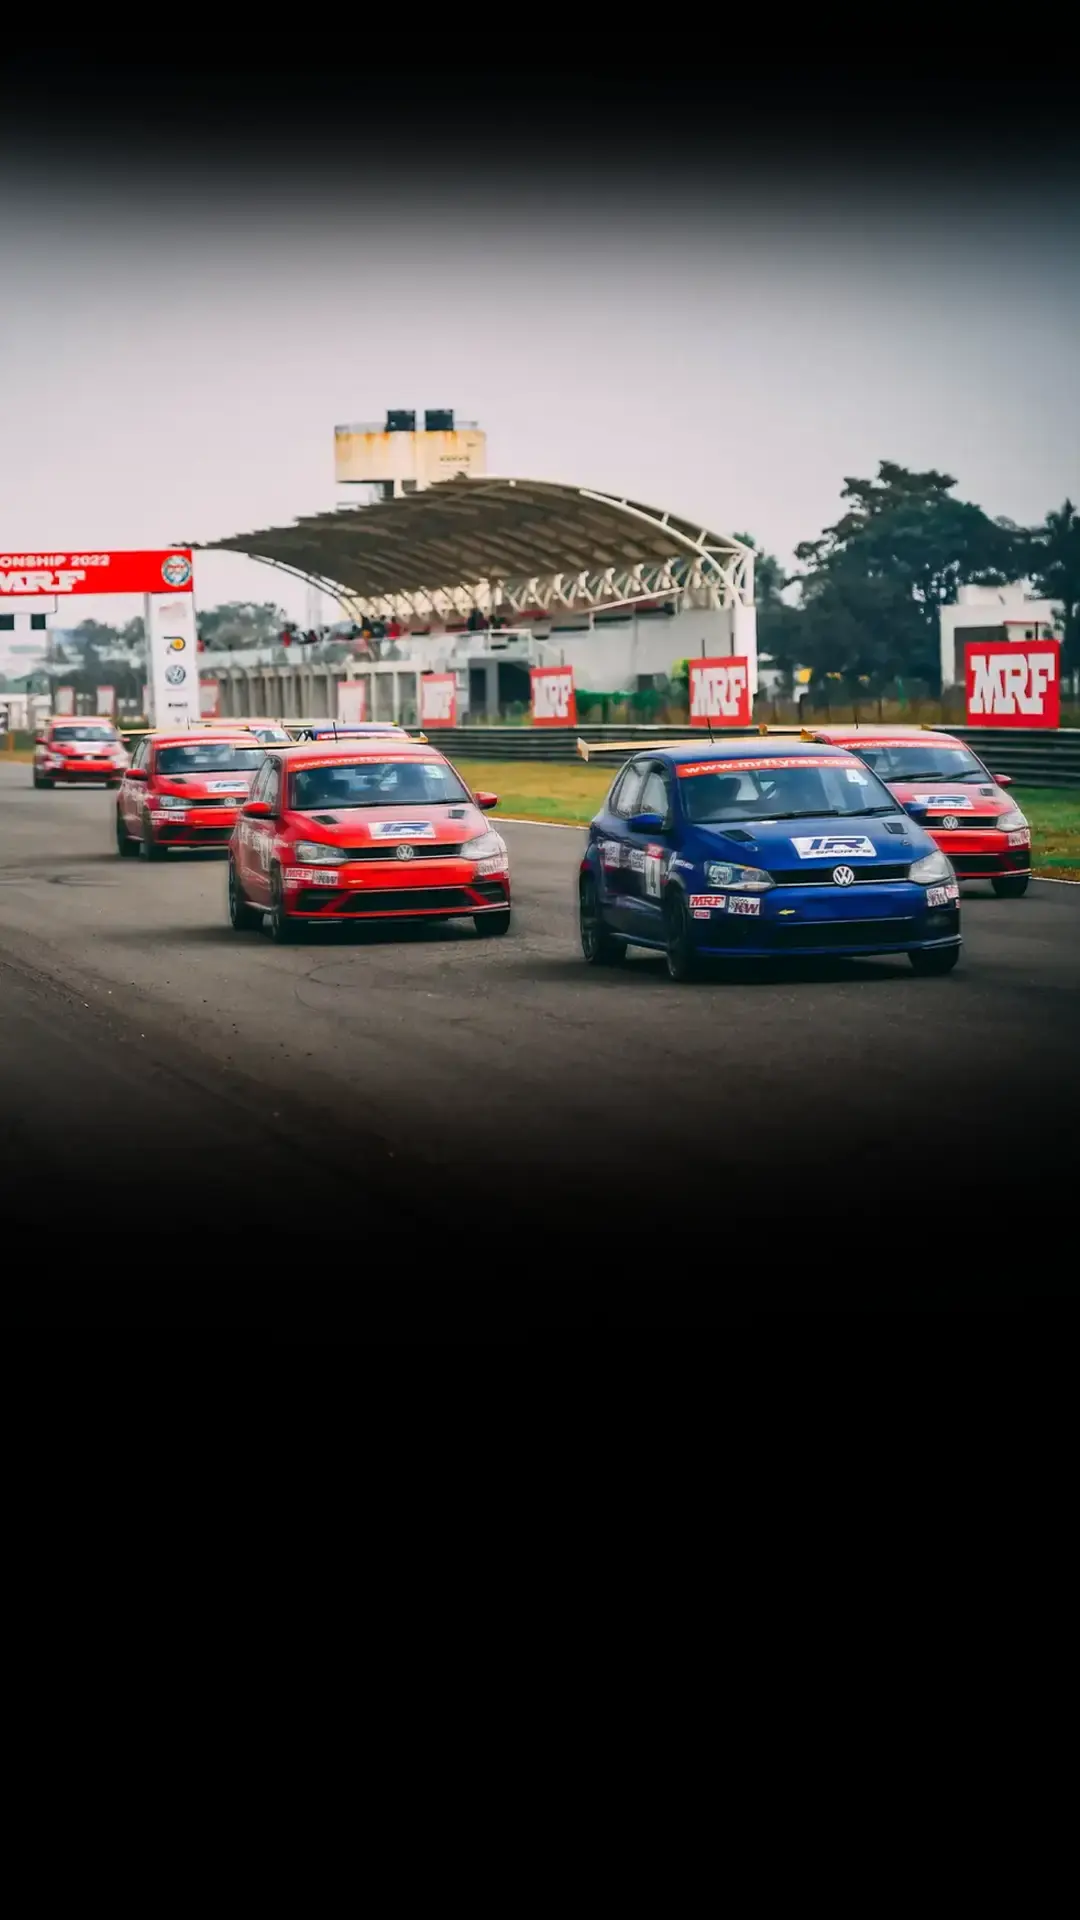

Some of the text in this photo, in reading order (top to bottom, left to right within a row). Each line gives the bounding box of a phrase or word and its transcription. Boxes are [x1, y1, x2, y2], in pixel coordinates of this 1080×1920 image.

[71, 554, 110, 567] 2022
[532, 674, 572, 718] MRF
[691, 665, 746, 717] MRF
[969, 653, 1055, 715] MRF
[691, 896, 725, 906] MRF
